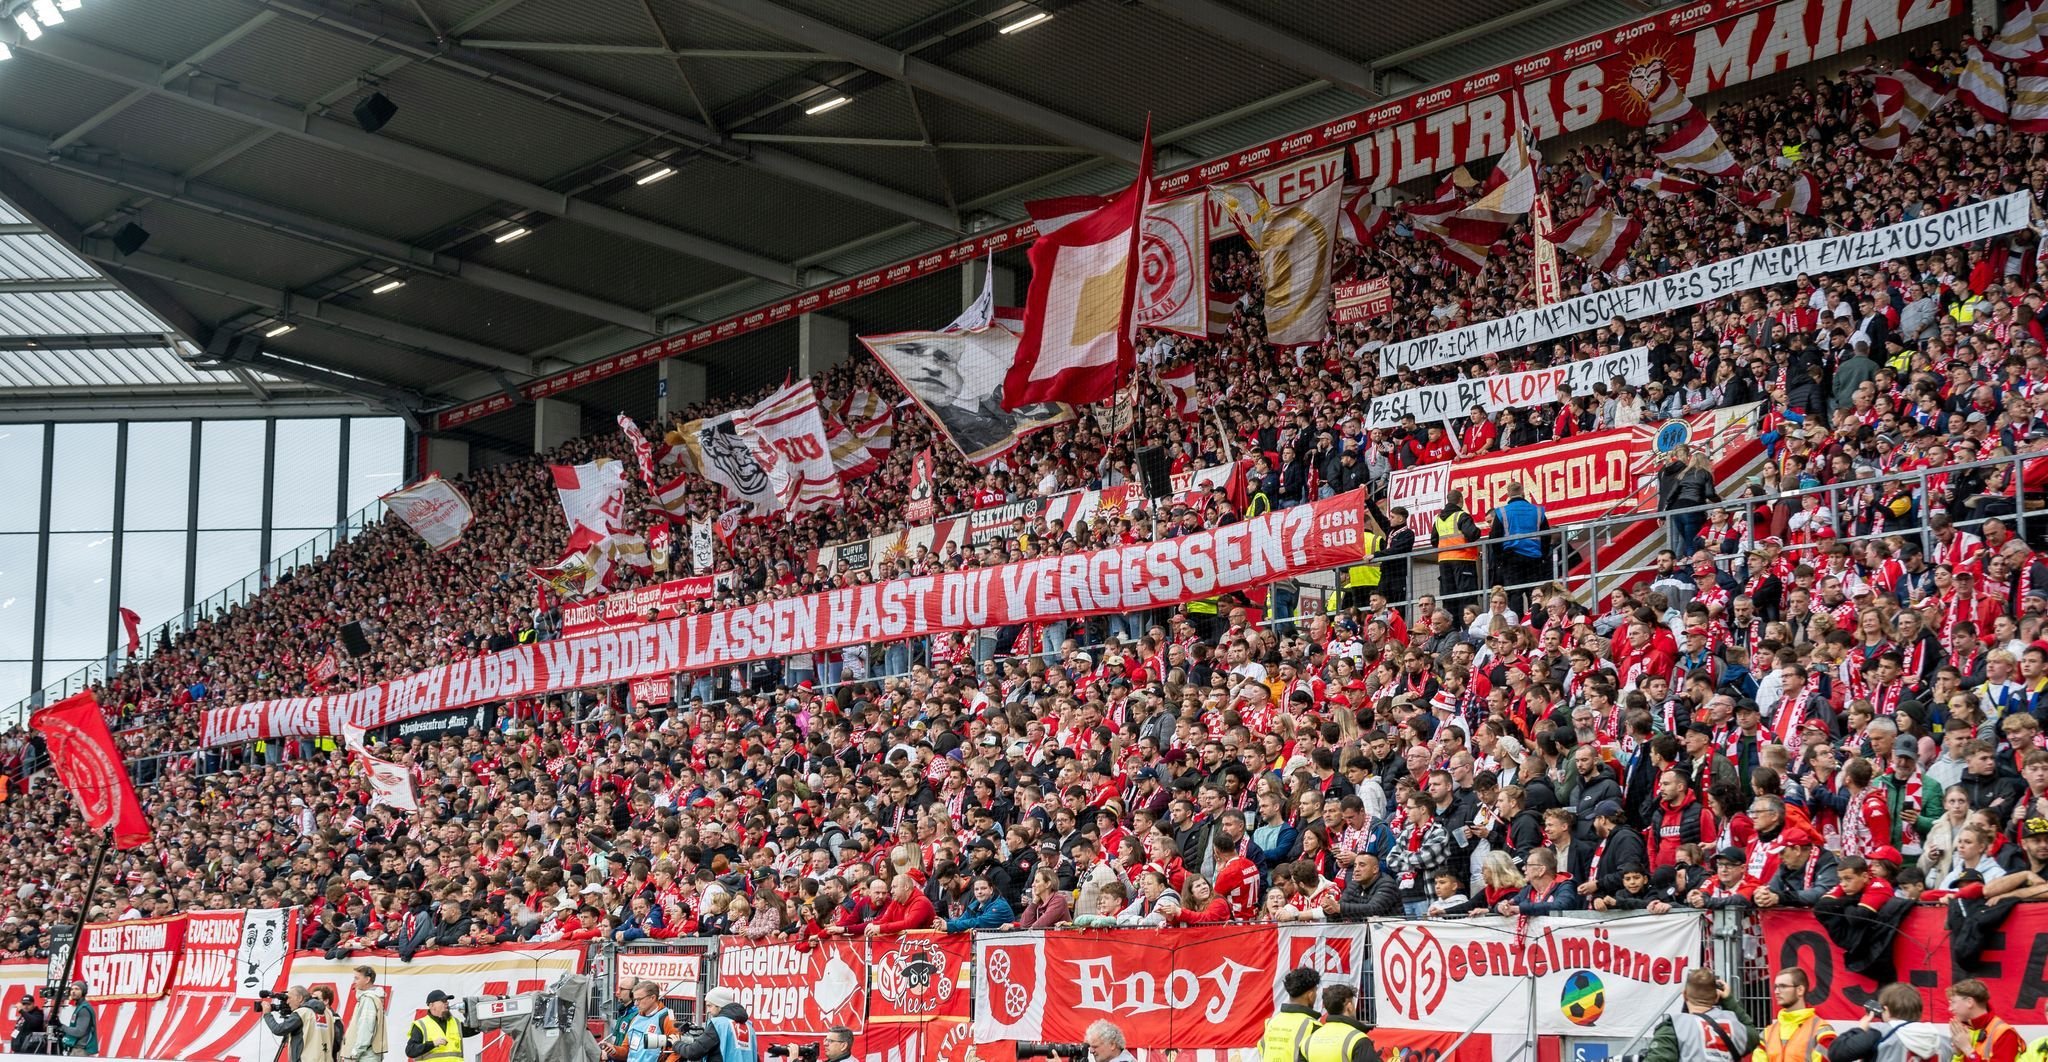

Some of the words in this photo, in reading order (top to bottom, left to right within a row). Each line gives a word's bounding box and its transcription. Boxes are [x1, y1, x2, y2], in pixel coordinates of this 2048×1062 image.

[1681, 4, 1712, 20] LOTTO
[1625, 22, 1655, 40] LOTTO
[1575, 40, 1602, 57] LOTTO
[1524, 57, 1550, 74] LOTTO
[1474, 73, 1500, 90] LOTTO
[1426, 89, 1452, 104] LOTTO
[1378, 105, 1402, 121] LOTTO
[1333, 120, 1356, 135] LOTTO
[1353, 64, 1604, 193] ULTRAS
[1290, 134, 1312, 148] LOTTO
[1248, 148, 1270, 161] LOTTO
[1208, 161, 1229, 175] LOTTO
[1168, 174, 1189, 188] LOTTO
[1023, 223, 1037, 234] LOTT
[989, 233, 1008, 245] LOTTO
[924, 254, 942, 266] LOTTO
[894, 265, 910, 276] LOTTO
[864, 275, 880, 286] LOTTO
[1334, 286, 1354, 299] FÜR
[1356, 276, 1388, 295] IMMER
[834, 285, 850, 296] LOTTO
[1340, 304, 1369, 321] MAINZ
[1384, 338, 1443, 374] KLOPP:
[1486, 315, 1526, 348] MAG
[1534, 281, 1661, 337] MENSCHEN,
[1420, 391, 1447, 413] DU
[1394, 469, 1444, 500] ZITTY
[971, 502, 1025, 528] SEKTION
[1319, 508, 1359, 531] USM
[1322, 528, 1358, 549] SUB
[843, 544, 862, 556] CURVA
[203, 702, 264, 747] ALLES
[268, 699, 321, 738] WAS
[326, 685, 381, 727] WIR
[386, 666, 445, 714] DICH
[446, 645, 536, 706] HABEN
[541, 620, 681, 690] WERDEN
[685, 597, 819, 671] LASSEN
[826, 574, 937, 644] HAST
[942, 567, 993, 627] DU
[1002, 503, 1315, 621] VERGESSEN?
[88, 926, 124, 952] BLEIBT
[124, 923, 167, 951] STRAMM
[188, 918, 239, 945] EUGENIOS
[81, 952, 149, 997] SEKTION
[148, 951, 172, 994] SV
[181, 948, 236, 988] BANDE
[622, 962, 694, 978] SUBURBIA
[1064, 955, 1265, 1025] Enoy
